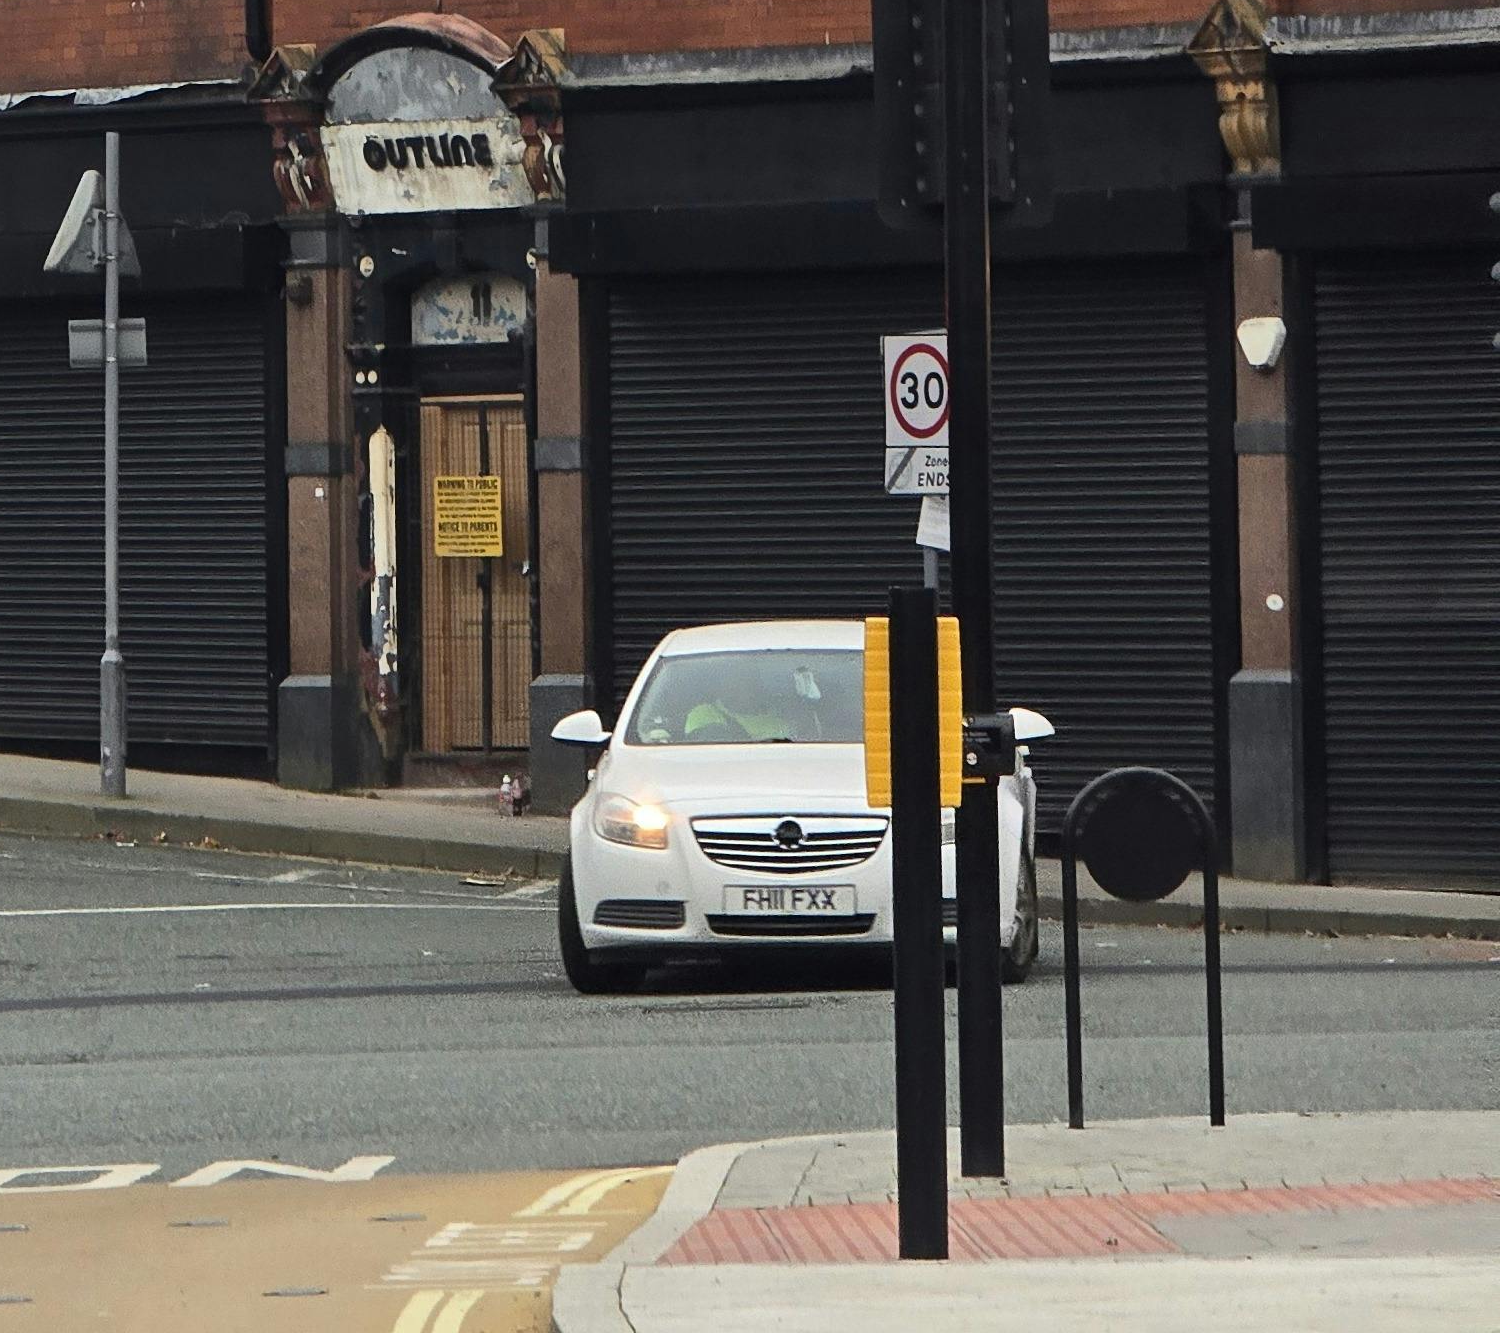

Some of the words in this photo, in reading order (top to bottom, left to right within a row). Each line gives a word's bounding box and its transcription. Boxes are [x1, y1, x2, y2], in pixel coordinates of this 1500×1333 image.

[900, 371, 944, 410] 30
[437, 479, 465, 489] WARNING
[475, 479, 498, 489] PUBLIC
[438, 522, 460, 532] NOTICE
[469, 521, 498, 532] PARENTS
